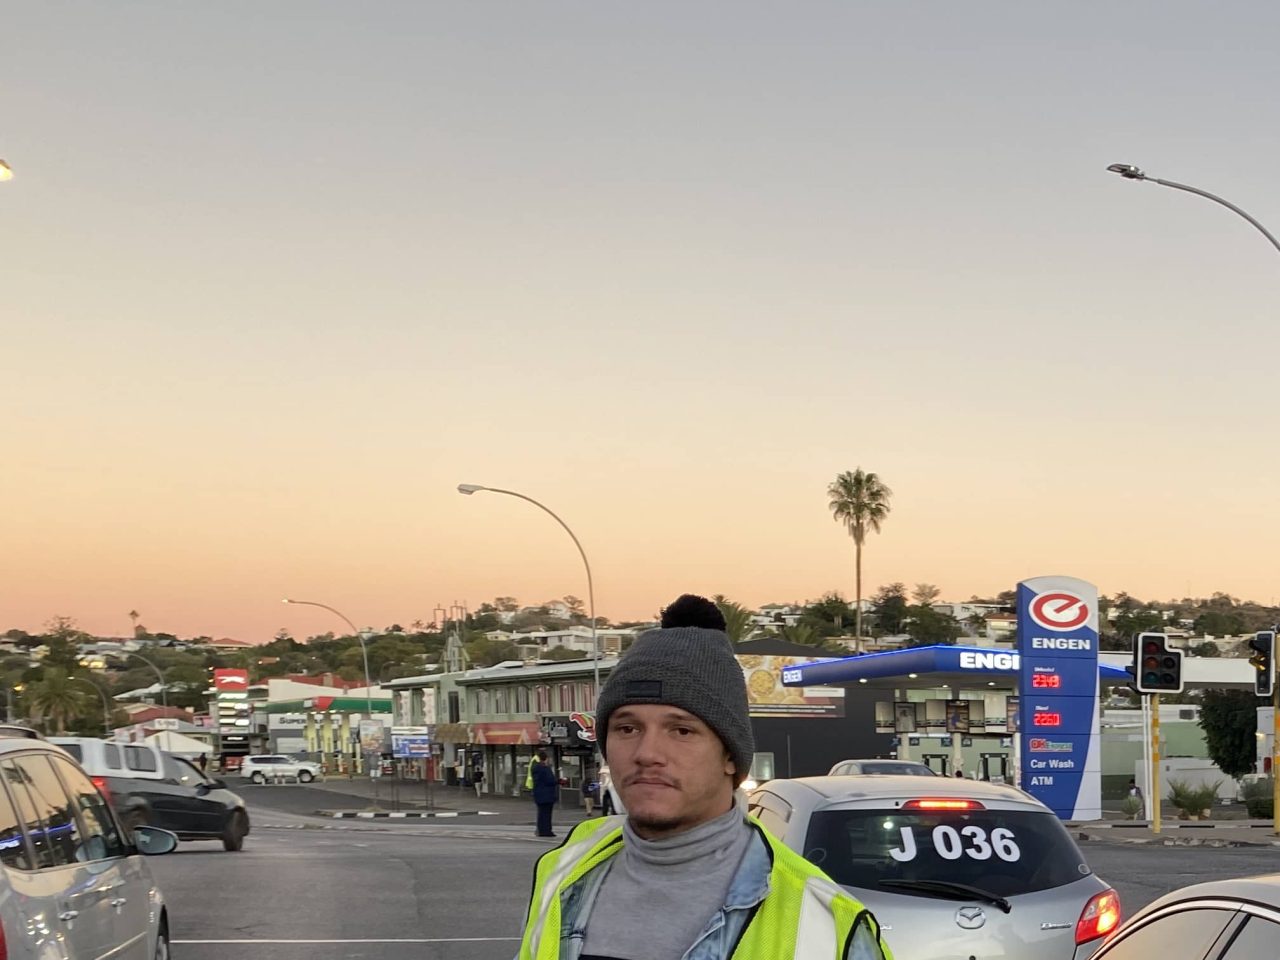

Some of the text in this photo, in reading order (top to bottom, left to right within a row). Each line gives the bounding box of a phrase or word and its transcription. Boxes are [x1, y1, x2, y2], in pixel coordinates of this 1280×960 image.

[1032, 638, 1091, 650] ENGEN
[1030, 759, 1075, 769] Car Wash
[1030, 776, 1054, 786] ATM
[889, 825, 1021, 862] J 036
